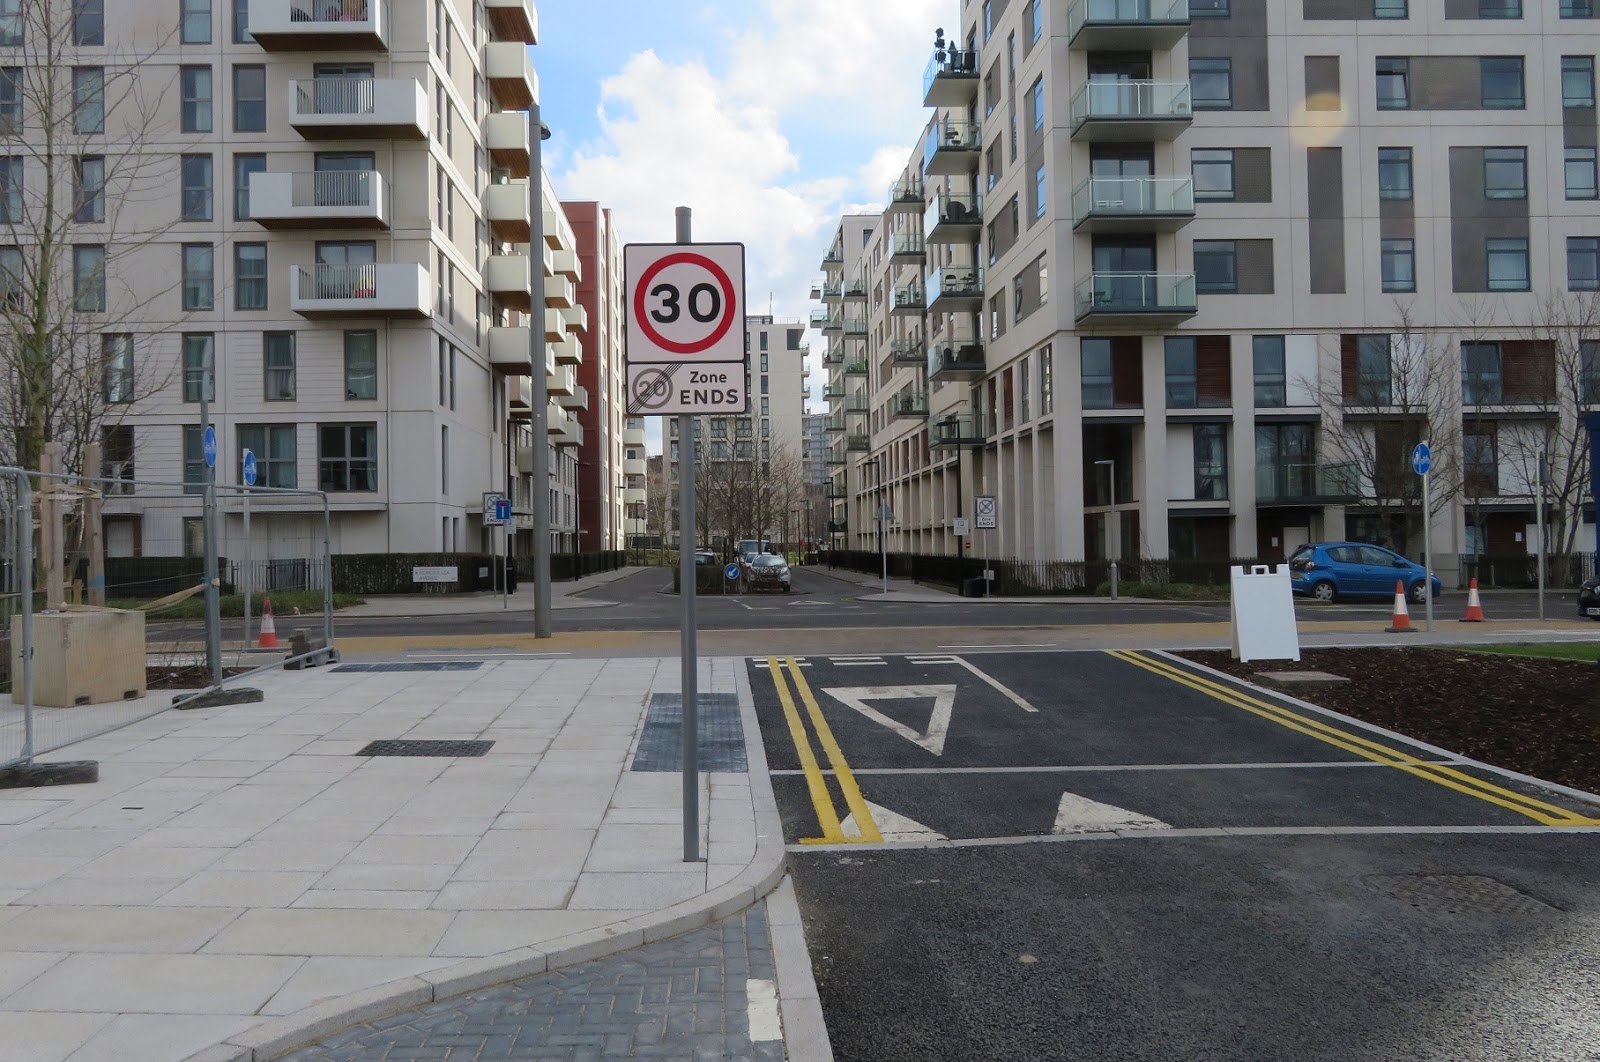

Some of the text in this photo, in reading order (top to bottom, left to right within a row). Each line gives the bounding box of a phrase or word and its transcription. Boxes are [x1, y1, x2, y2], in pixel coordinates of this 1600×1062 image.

[650, 283, 720, 323] 30
[690, 371, 727, 383] Zone
[638, 380, 667, 397] 20
[680, 389, 738, 404] ENDS
